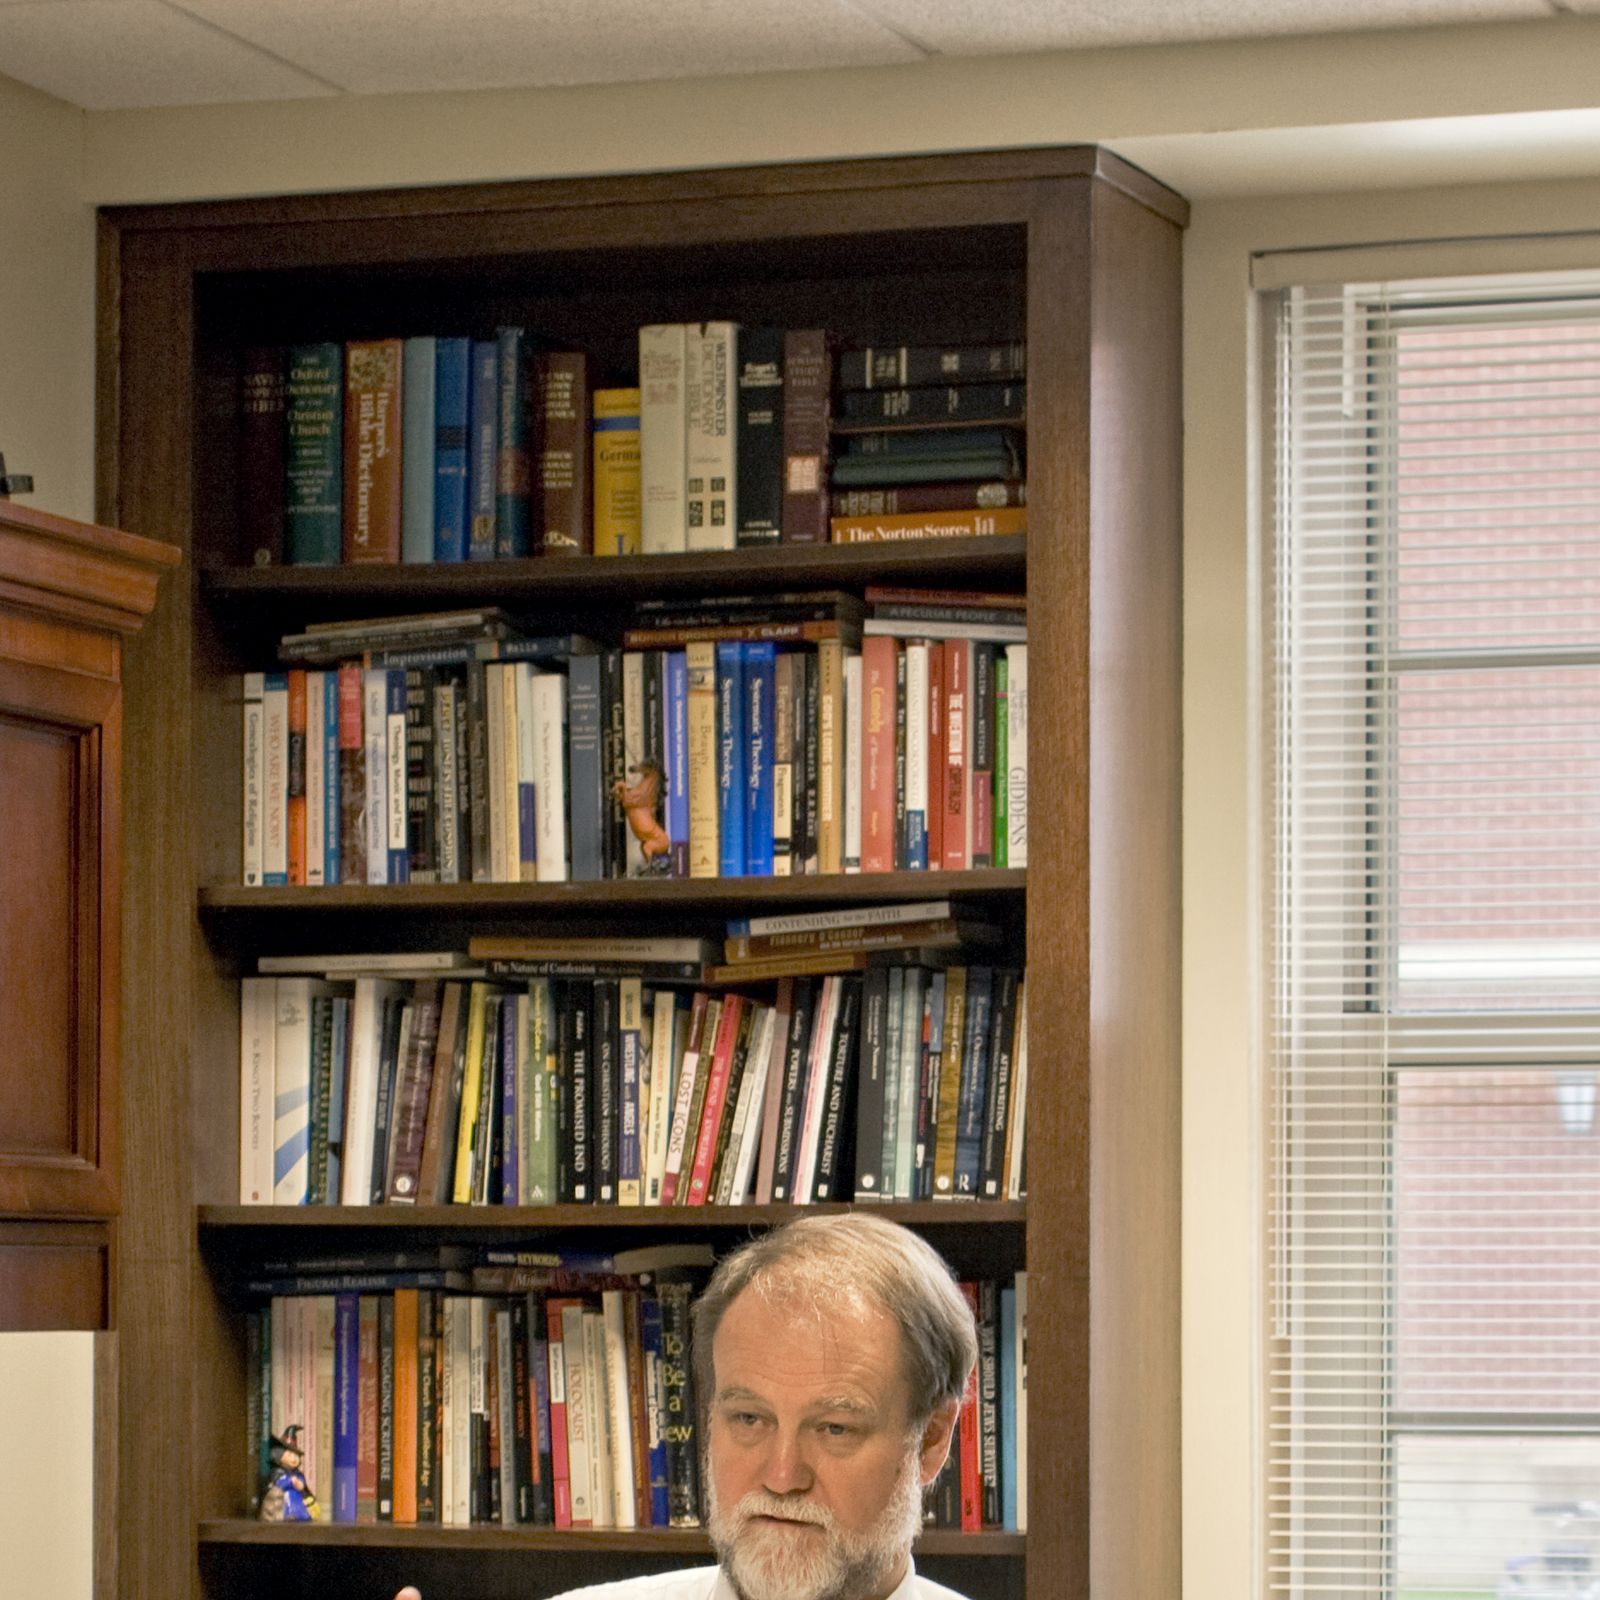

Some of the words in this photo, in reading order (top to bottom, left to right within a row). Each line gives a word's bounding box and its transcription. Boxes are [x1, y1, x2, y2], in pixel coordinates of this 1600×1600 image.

[714, 341, 726, 437] WESTMINSTER
[290, 424, 331, 436] Church
[353, 441, 374, 547] Dictionary
[847, 526, 874, 542] The
[876, 525, 924, 541] Norton
[925, 523, 971, 538] Scores
[900, 609, 952, 619] PECULIAR
[955, 611, 996, 621] PEOPLE
[383, 648, 469, 666] Improvisation
[978, 654, 986, 696] NIHILISM
[721, 678, 732, 735] Systematic
[750, 678, 762, 735] Systematic
[868, 687, 884, 733] Comedy
[948, 694, 963, 710] THE
[246, 713, 259, 779] Genealogies
[269, 713, 280, 750] WHO
[392, 724, 402, 766] Theology,
[700, 725, 710, 766] Beauty
[822, 732, 832, 762] LONG
[948, 711, 963, 753] INVENTION
[270, 753, 279, 779] ARE
[690, 752, 700, 801] Infinite
[721, 738, 733, 789] Theology
[750, 738, 762, 789] Theology
[948, 755, 963, 766] OF
[270, 782, 279, 804] WE
[393, 768, 402, 795] Music
[776, 767, 786, 818] Fragments
[822, 765, 832, 821] SUMMER
[948, 768, 962, 815] CAPITALISM
[246, 799, 258, 847] Religion
[369, 798, 381, 850] Augustine
[393, 798, 402, 814] and
[1009, 767, 1026, 846] GIDDENS
[269, 806, 280, 847] NOW?
[393, 817, 402, 839] Time
[765, 914, 841, 930] CONTENDING
[867, 907, 901, 922] FAITH
[493, 961, 508, 973] The
[510, 961, 537, 973] Nature
[539, 961, 548, 973] of
[549, 961, 596, 974] Confession
[574, 1050, 585, 1074] THE
[601, 1042, 610, 1060] ON
[623, 1034, 635, 1083] WRESTLING
[787, 1048, 800, 1091] POWERS
[833, 1033, 849, 1083] TORTURE
[998, 1053, 1009, 1084] AFTER
[534, 1074, 542, 1090] God
[534, 1093, 542, 1109] Still
[601, 1062, 610, 1116] CHRISTIAN
[679, 1072, 693, 1107] LOST
[829, 1085, 841, 1111] AND
[534, 1111, 542, 1141] Matters
[574, 1078, 585, 1141] PROMISED
[623, 1102, 635, 1135] ANGELS
[994, 1086, 1007, 1131] WRITING
[601, 1118, 610, 1171] THEOLOGY
[669, 1112, 687, 1154] ICONS
[696, 1119, 713, 1167] KNOWLEDGE
[778, 1106, 795, 1173] SUBMISSIONS
[820, 1113, 840, 1176] EUCHARIST
[574, 1145, 584, 1172] END
[517, 1252, 561, 1267] KEYWORDS
[296, 1278, 339, 1289] FIGURAL
[342, 1275, 387, 1288] REALISM
[444, 1312, 452, 1327] The
[444, 1330, 452, 1358] Nature
[661, 1333, 685, 1355] To
[982, 1328, 995, 1354] WHY
[381, 1347, 391, 1414] ENGAGING
[422, 1358, 432, 1373] The
[661, 1365, 687, 1387] Be
[982, 1356, 996, 1399] SHOULD
[422, 1375, 432, 1407] Church
[444, 1370, 452, 1408] Doctrine
[569, 1363, 585, 1443] HOLOCAUST
[668, 1395, 682, 1412] a
[983, 1402, 996, 1433] JEWS
[380, 1417, 391, 1481] SCRIPTURE
[421, 1421, 431, 1468] Postliberal
[983, 1435, 997, 1487] SURVIVE?
[420, 1470, 430, 1486] Age
